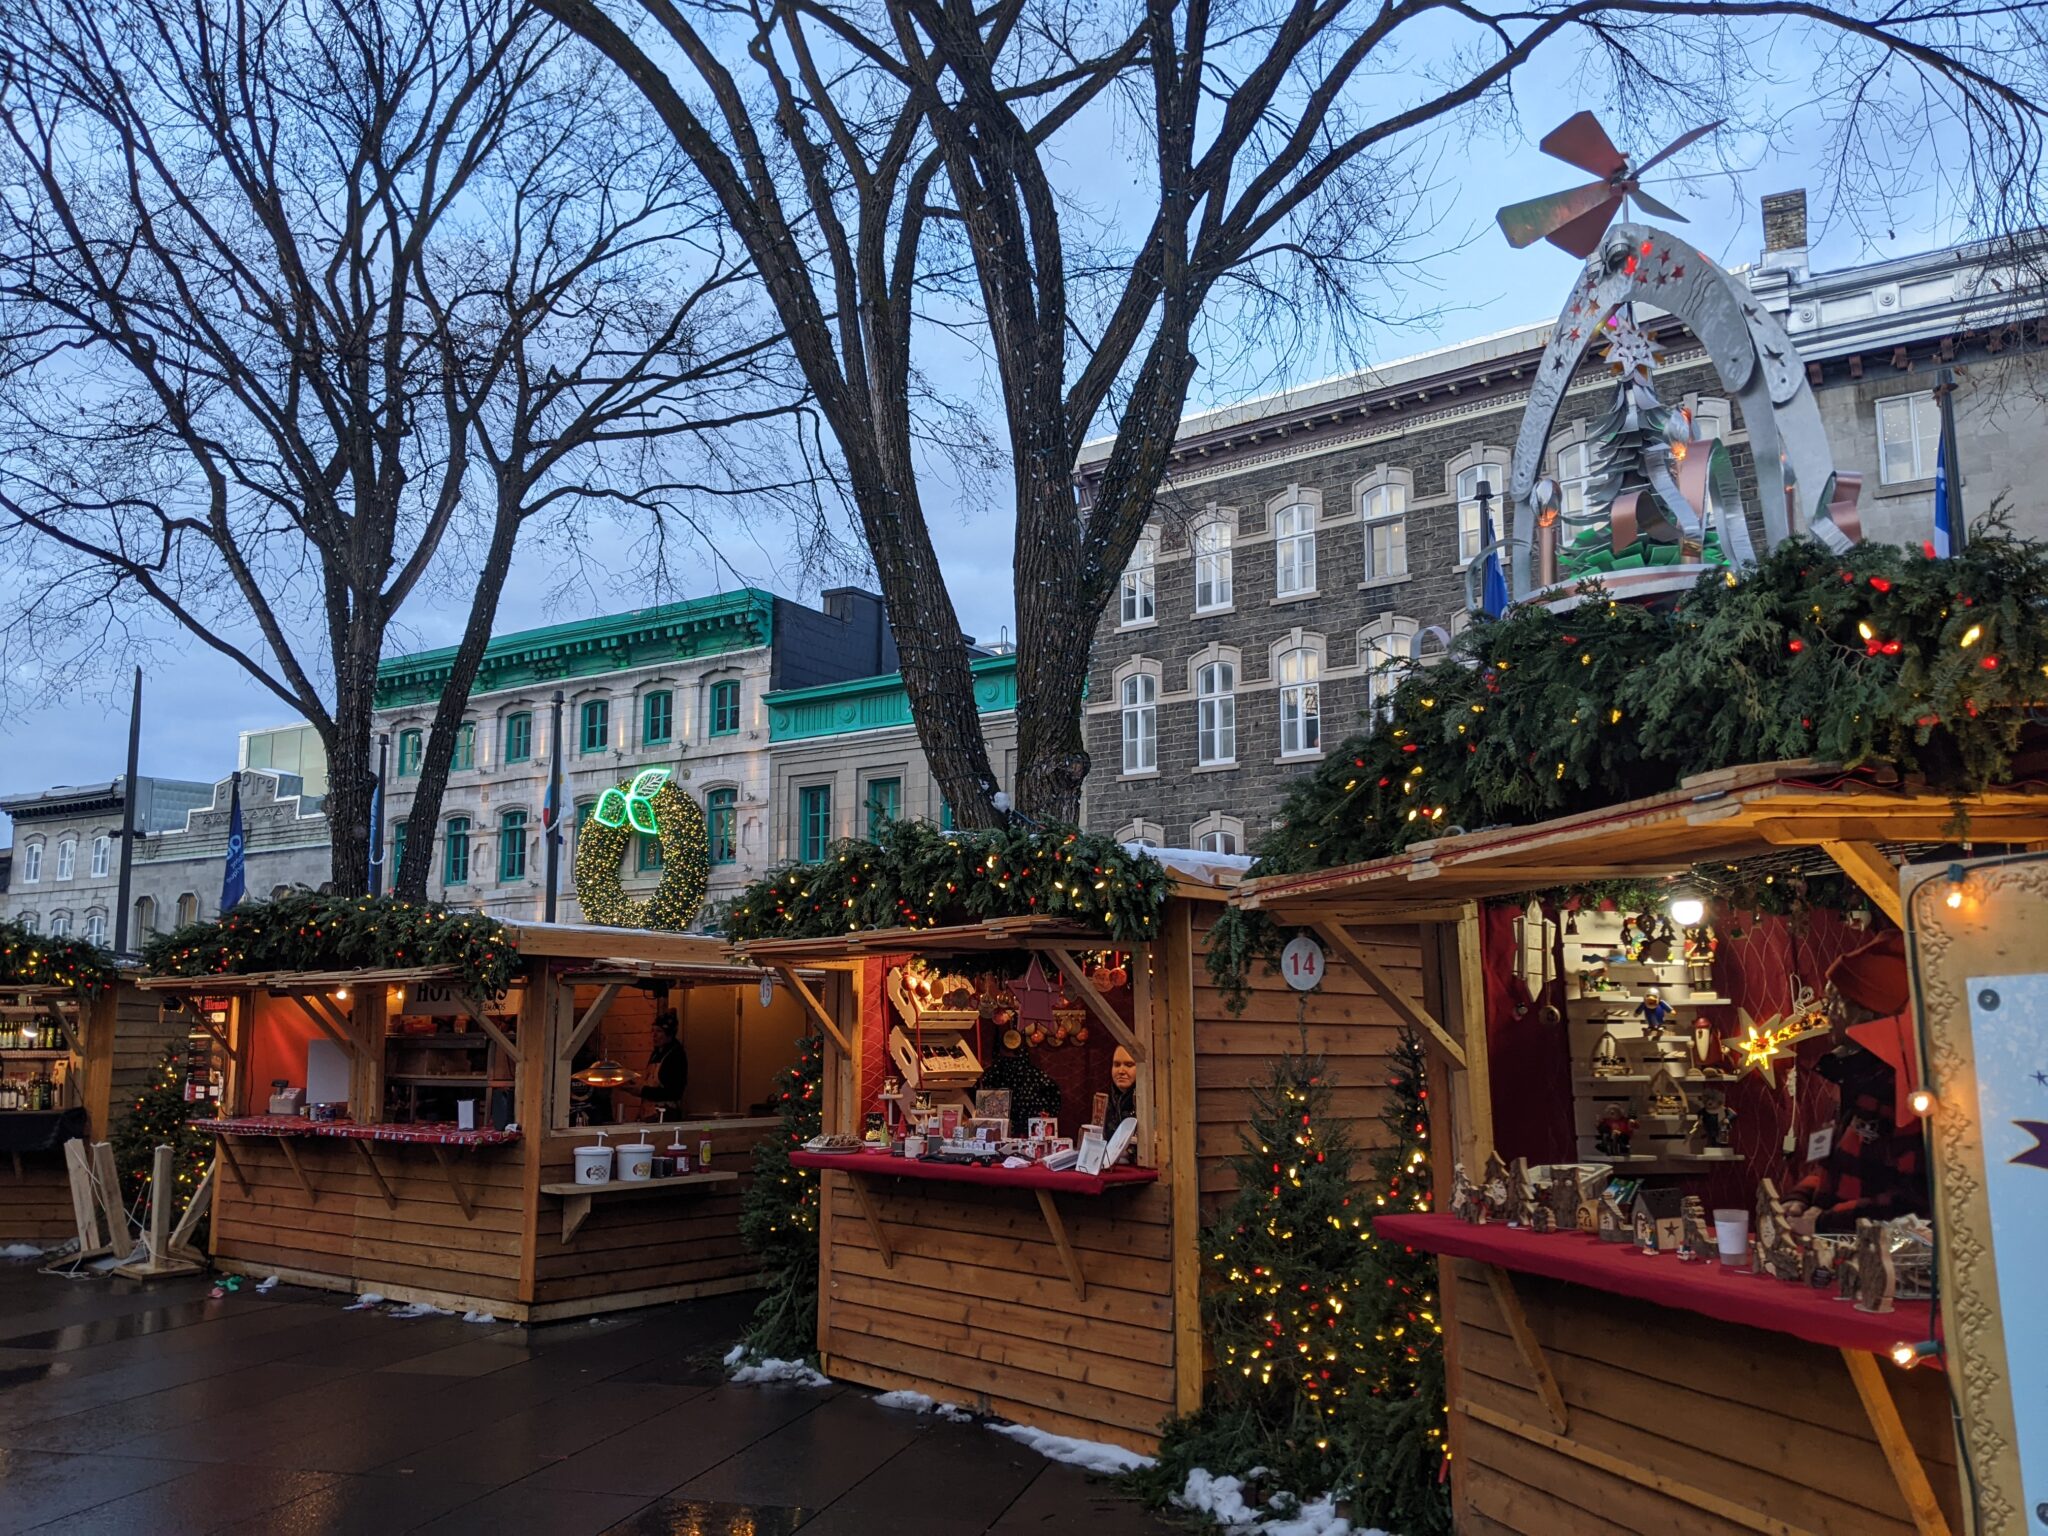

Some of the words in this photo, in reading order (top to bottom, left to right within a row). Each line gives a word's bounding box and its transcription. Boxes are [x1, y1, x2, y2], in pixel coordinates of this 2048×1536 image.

[218, 773, 275, 799] epire
[1290, 952, 1315, 976] 14
[416, 983, 451, 1002] HOT
